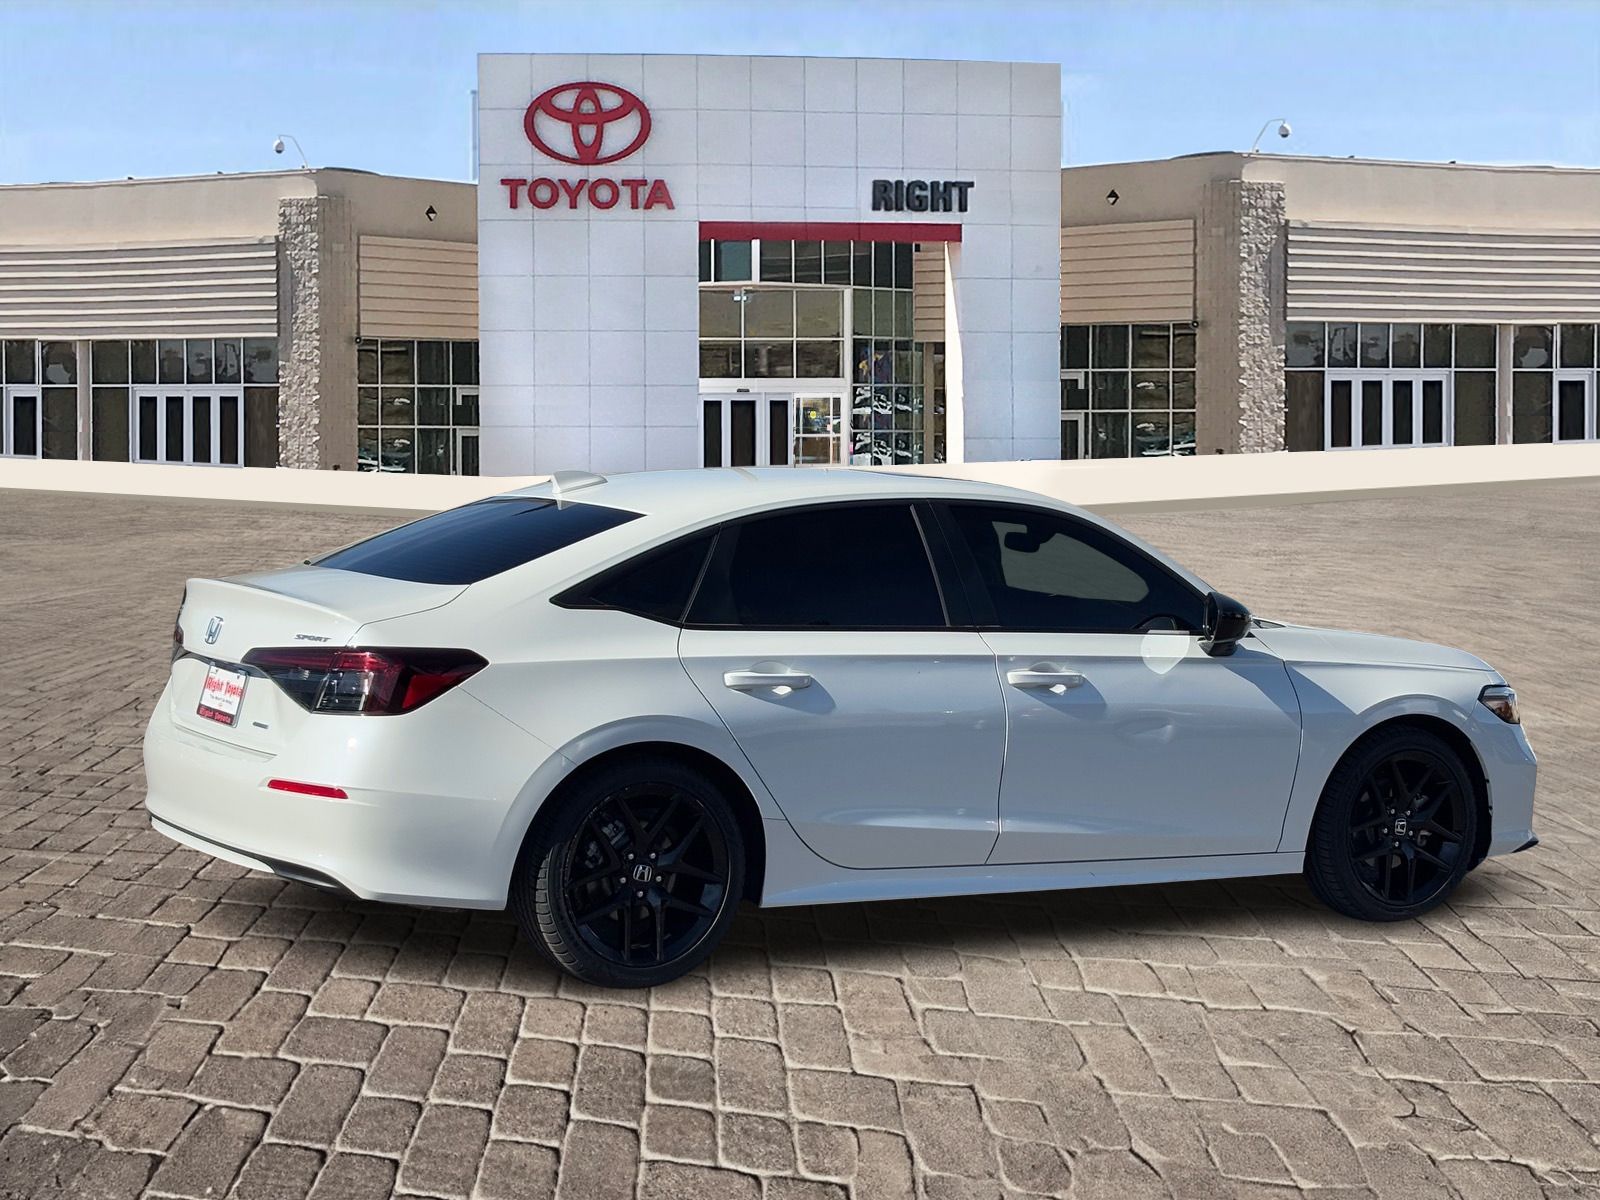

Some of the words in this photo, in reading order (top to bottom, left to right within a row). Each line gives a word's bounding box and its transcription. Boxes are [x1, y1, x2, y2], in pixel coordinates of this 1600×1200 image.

[501, 178, 675, 209] TOYOTA
[872, 180, 975, 212] RIGHT
[294, 633, 331, 643] SPORT
[206, 676, 223, 692] Right
[225, 681, 244, 697] Toyota
